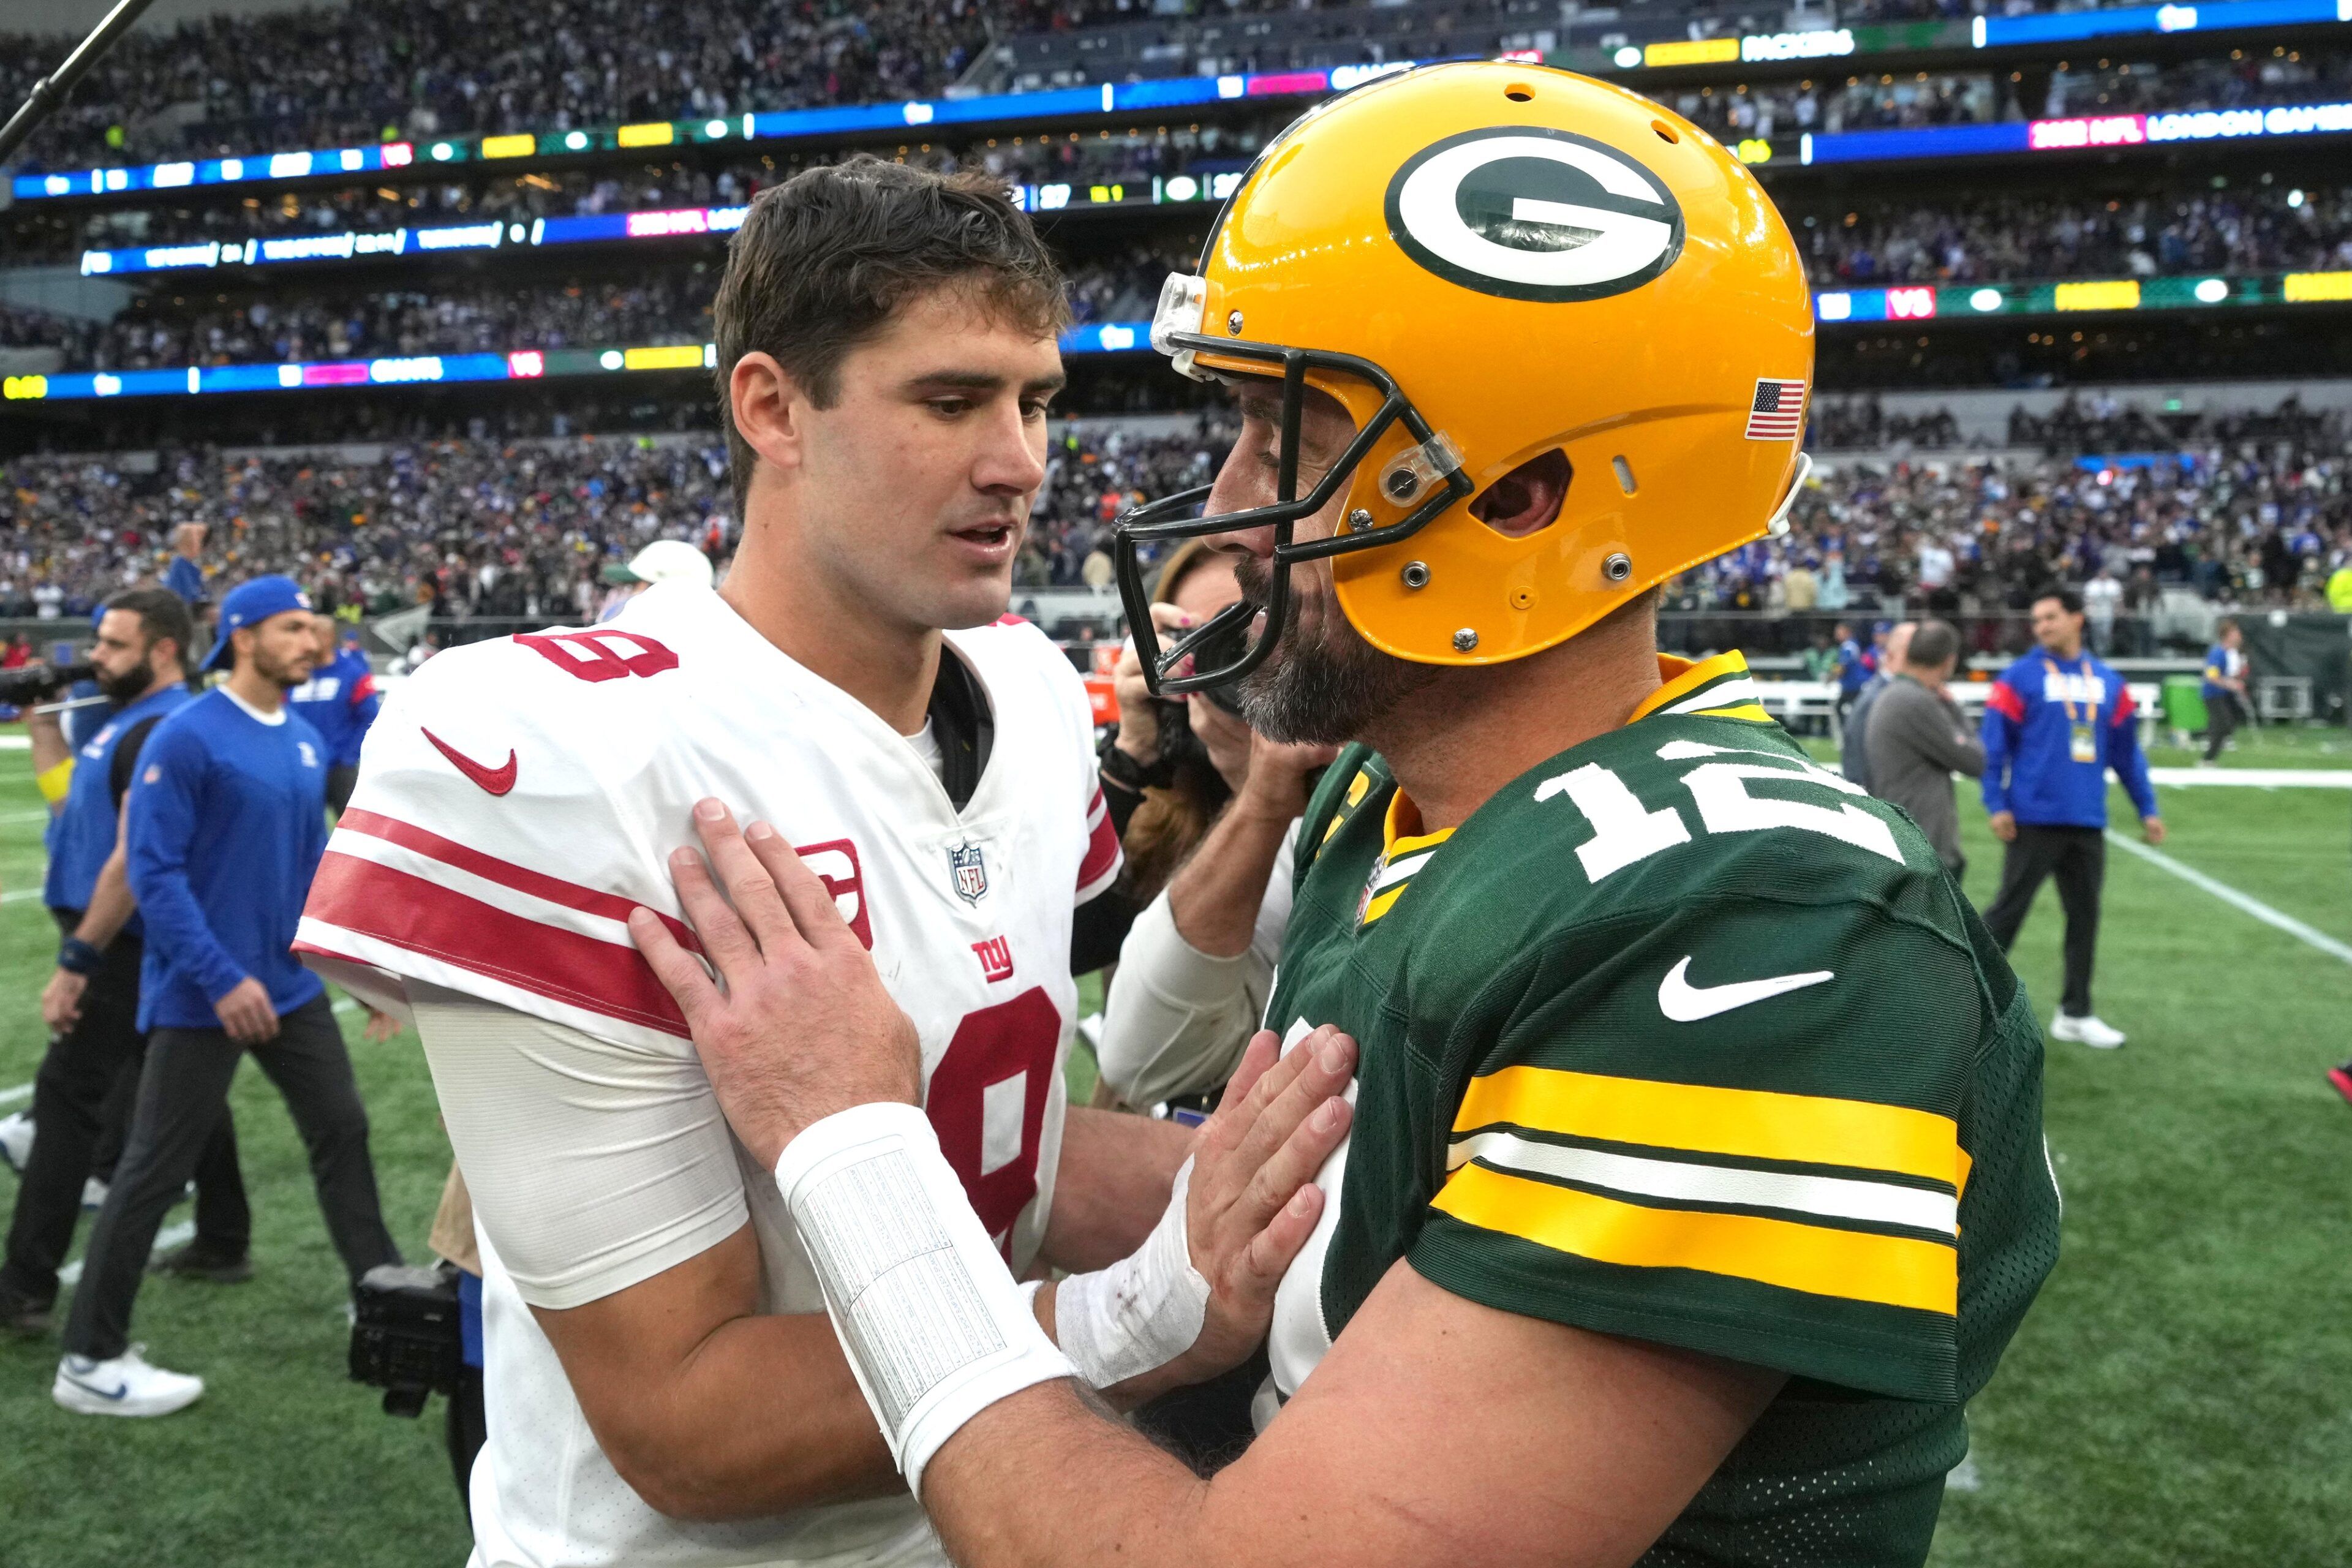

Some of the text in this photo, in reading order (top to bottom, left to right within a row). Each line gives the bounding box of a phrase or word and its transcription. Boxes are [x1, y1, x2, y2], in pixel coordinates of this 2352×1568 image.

[2147, 109, 2263, 141] LONDON
[1399, 136, 1672, 286] G
[1890, 288, 1933, 317] VS
[1533, 740, 1906, 884] 12
[957, 867, 984, 894] NFL
